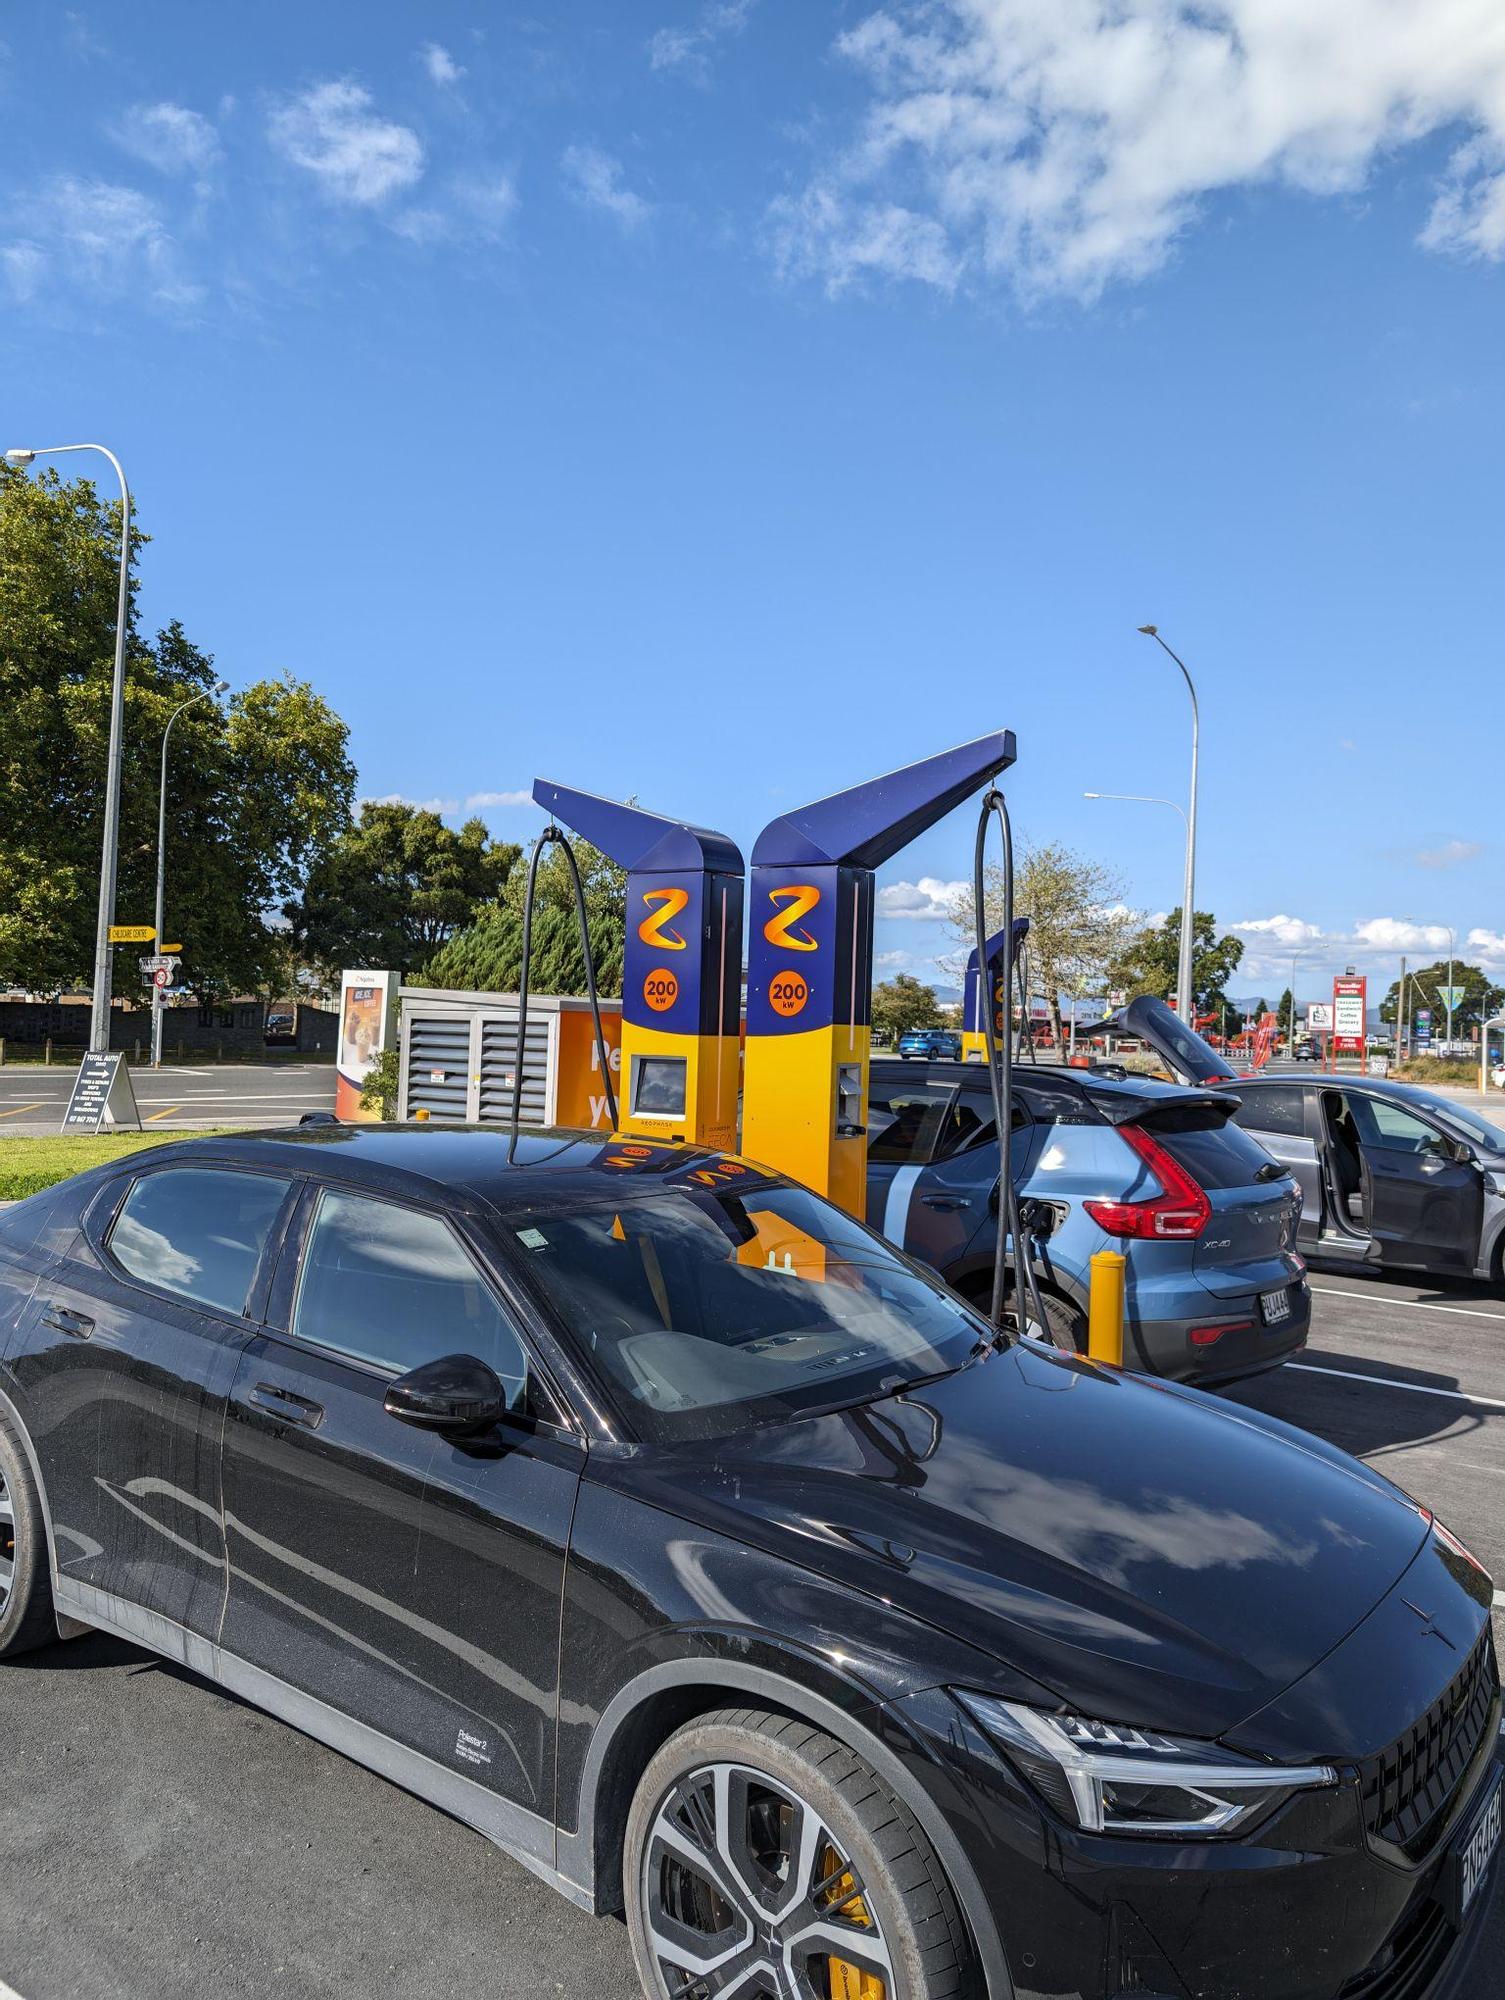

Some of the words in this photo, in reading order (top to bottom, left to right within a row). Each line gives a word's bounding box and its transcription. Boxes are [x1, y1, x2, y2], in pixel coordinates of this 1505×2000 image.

[638, 888, 689, 950] Z
[763, 885, 821, 951] Z
[647, 981, 676, 996] 200
[773, 984, 806, 1000] 200
[481, 1740, 487, 1750] 2
